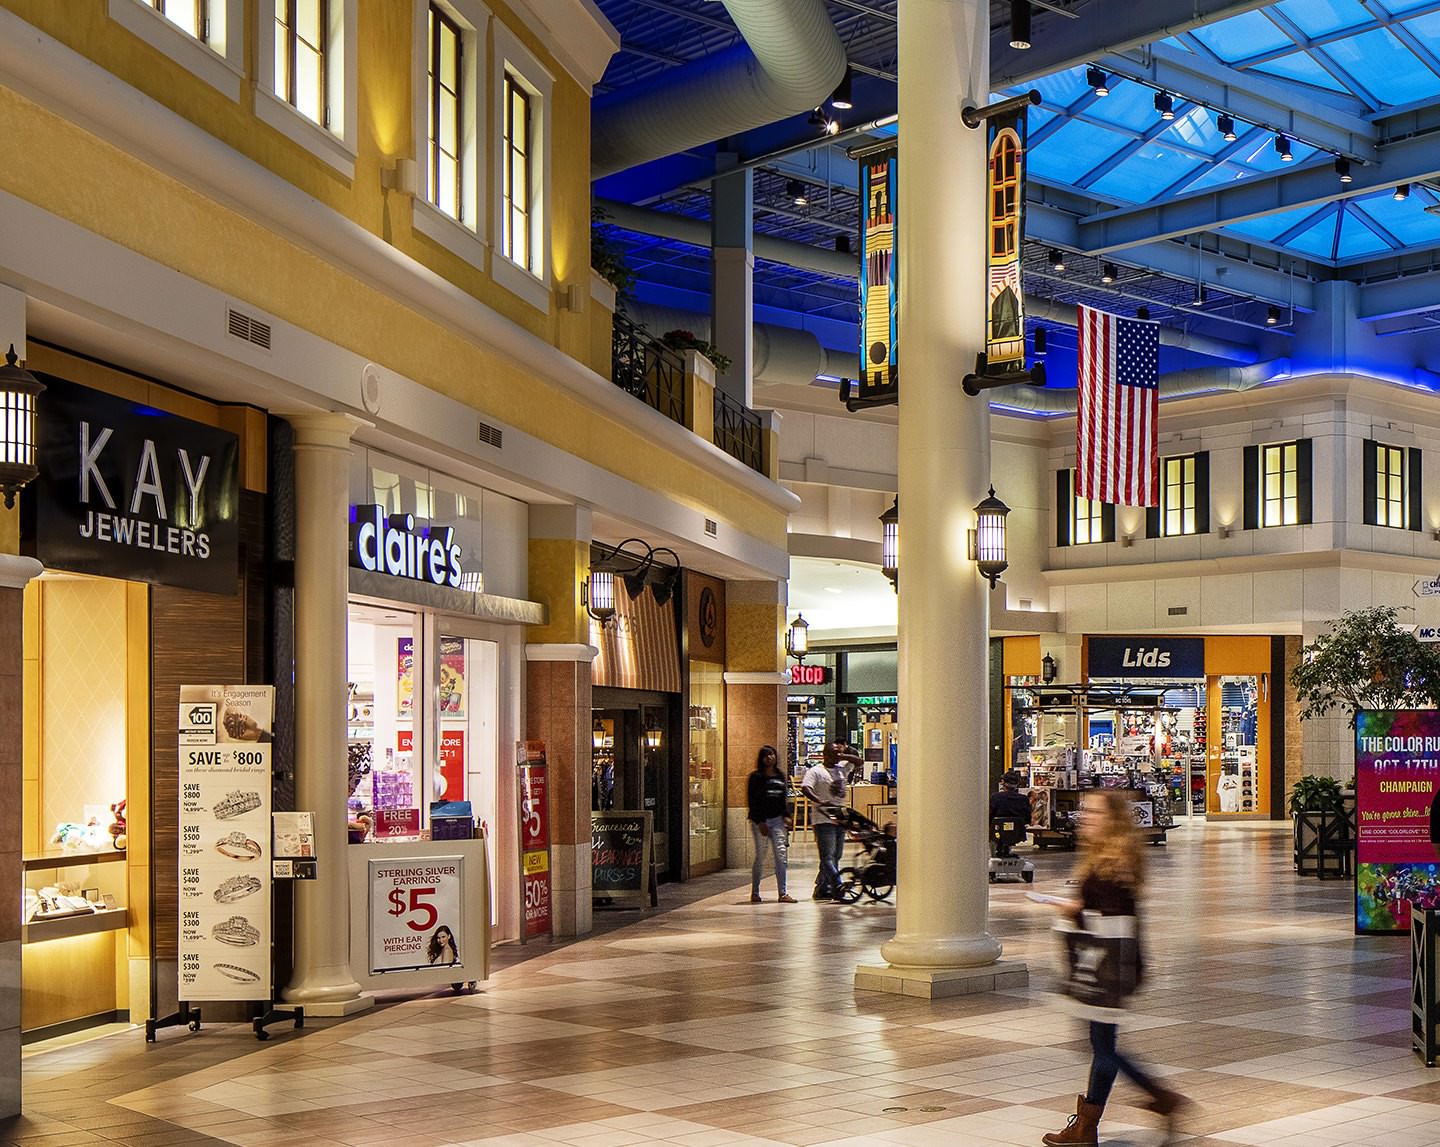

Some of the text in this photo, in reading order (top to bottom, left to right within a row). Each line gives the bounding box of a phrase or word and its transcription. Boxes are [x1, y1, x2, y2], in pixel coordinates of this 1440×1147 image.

[80, 421, 211, 528] KAY
[79, 510, 211, 560] JEWELERS
[358, 504, 463, 589] claire's
[1419, 627, 1435, 638] MC
[1122, 647, 1171, 668] Lids
[792, 665, 824, 684] Stop
[211, 690, 267, 699] It's Engagement
[225, 699, 252, 707] Season
[190, 712, 211, 724] 100
[440, 738, 461, 747] TORE
[1360, 736, 1384, 752] THE
[1384, 736, 1423, 752] COLOR
[188, 751, 222, 766] SAVE
[1374, 759, 1438, 774] OCT 17TH
[183, 783, 200, 791] SAVE
[1379, 781, 1433, 793] CHAMPAIGN
[183, 791, 200, 799] $800
[383, 810, 413, 822] FREE
[522, 798, 541, 837] $5
[1361, 810, 1381, 821] You're
[183, 825, 200, 833] SAVE
[388, 825, 408, 836] 20%
[183, 833, 200, 841] $500
[528, 855, 542, 866] NEW
[183, 868, 200, 876] SAVE
[377, 866, 456, 880] STERLING SILVER
[183, 876, 200, 884] $400
[393, 875, 442, 886] EARRINGS
[524, 879, 549, 910] 50%
[183, 911, 200, 919] SAVE
[388, 887, 439, 932] $5
[183, 919, 200, 927] $300
[383, 935, 423, 945] WITH EAR
[384, 942, 422, 952] PIERCING
[183, 963, 200, 971] $300
